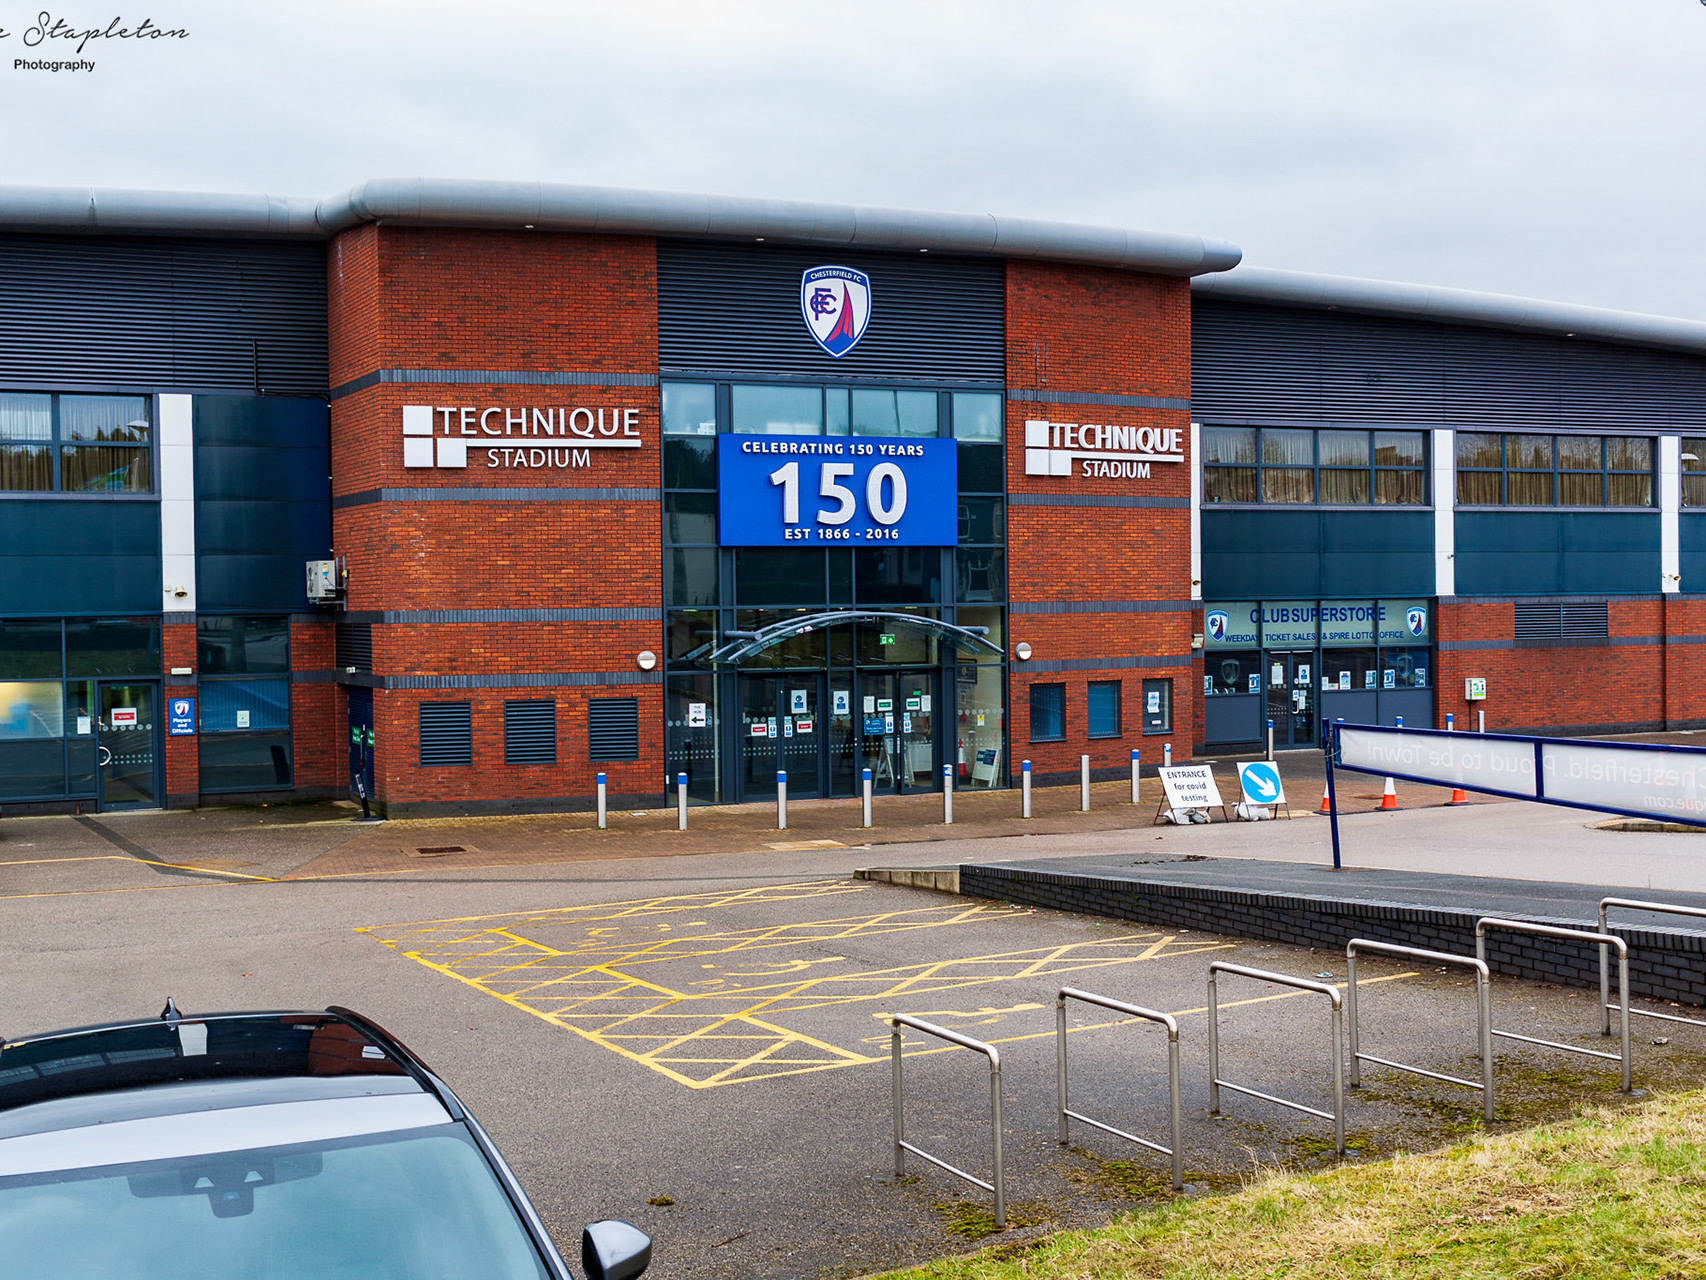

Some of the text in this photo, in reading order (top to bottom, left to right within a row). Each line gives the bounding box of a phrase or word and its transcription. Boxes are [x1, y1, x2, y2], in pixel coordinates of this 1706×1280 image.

[810, 270, 862, 282] CHESTERFIELD FC
[436, 407, 640, 438] TECHNIQUE
[1049, 423, 1184, 454] TECHNIQUE
[742, 441, 924, 456] CELEBRATING 150 YEARS
[487, 448, 591, 468] STADIUM
[1082, 460, 1150, 479] STADIUM
[769, 461, 907, 525] 150
[784, 528, 810, 540] EST
[817, 528, 850, 540] 1866
[865, 528, 899, 540] 2016
[1225, 631, 1404, 642] WEEKDAY TICKET SALES & SPIRE LOTTO OFFICE
[1166, 770, 1207, 779] ENTRANCE
[1174, 782, 1207, 790] for covid
[1181, 793, 1209, 803] testing
